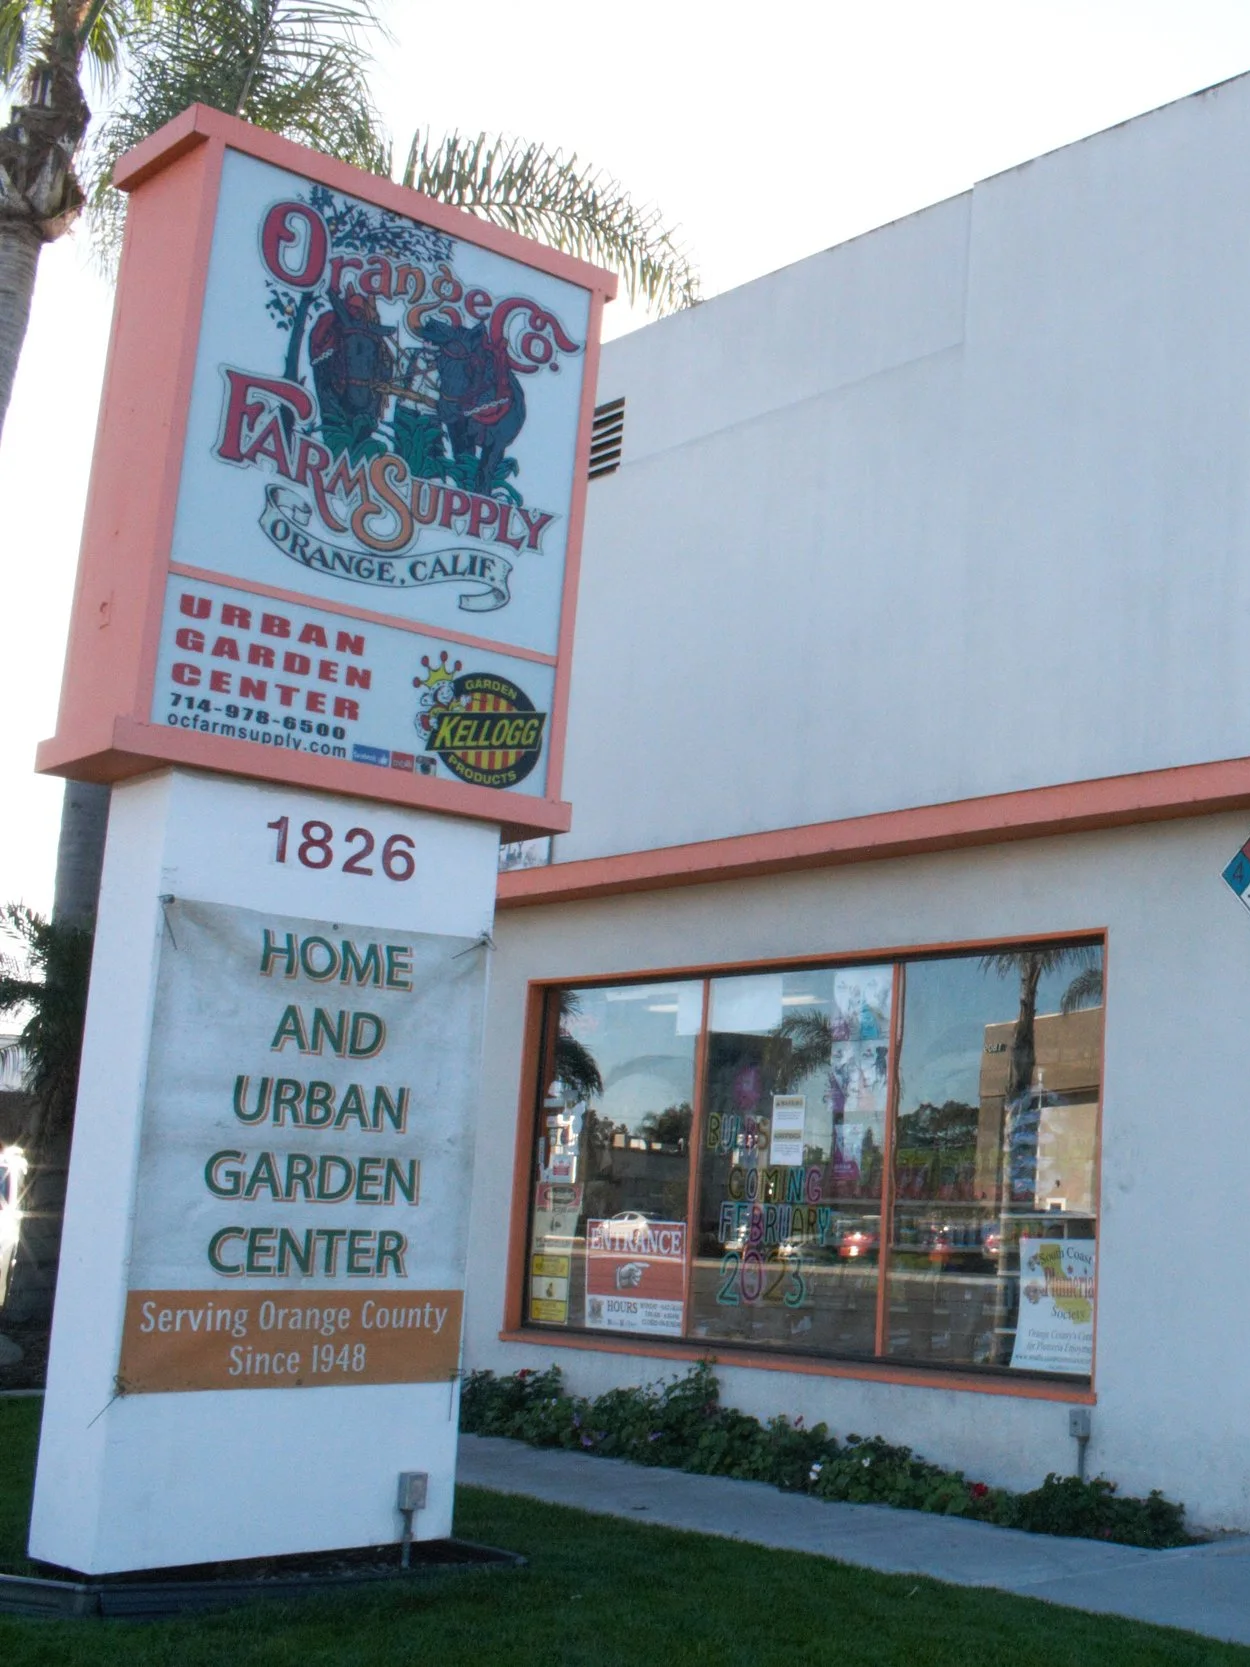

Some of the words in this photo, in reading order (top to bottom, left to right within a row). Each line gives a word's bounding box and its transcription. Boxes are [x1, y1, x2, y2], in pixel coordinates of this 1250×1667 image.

[259, 200, 493, 336] Orange
[487, 296, 581, 374] Co.
[216, 367, 371, 534] FARM
[350, 454, 555, 551] SUPPLY
[408, 555, 498, 583] CALIF.
[179, 592, 366, 657] URBAN
[175, 627, 373, 690] GARDEN
[171, 662, 361, 722] CENTER
[464, 678, 518, 700] GARDEN
[167, 712, 348, 759] ocfarmsupply.com
[170, 691, 347, 741] 714-978-6500
[433, 714, 541, 748] KELLOGG
[448, 754, 518, 785] PRODUCTS
[266, 815, 416, 882] 1826
[1232, 862, 1244, 883] 4
[259, 928, 414, 993] HOME
[269, 1004, 387, 1061] AND
[232, 1074, 411, 1135] URBAN
[204, 1149, 421, 1207] GARDEN
[727, 1165, 824, 1206] COMING
[590, 1227, 682, 1255] ENTRANCE
[717, 1200, 832, 1247] FEBRUARY
[207, 1225, 409, 1278] CENTER
[1039, 1248, 1065, 1265] South
[1066, 1246, 1093, 1265] Coast
[715, 1250, 806, 1309] 2023
[139, 1300, 249, 1338] Serving
[258, 1300, 350, 1337] Orange
[360, 1299, 449, 1335] County
[607, 1300, 638, 1314] HOURS
[228, 1344, 301, 1376] Since
[311, 1342, 367, 1373] 1948
